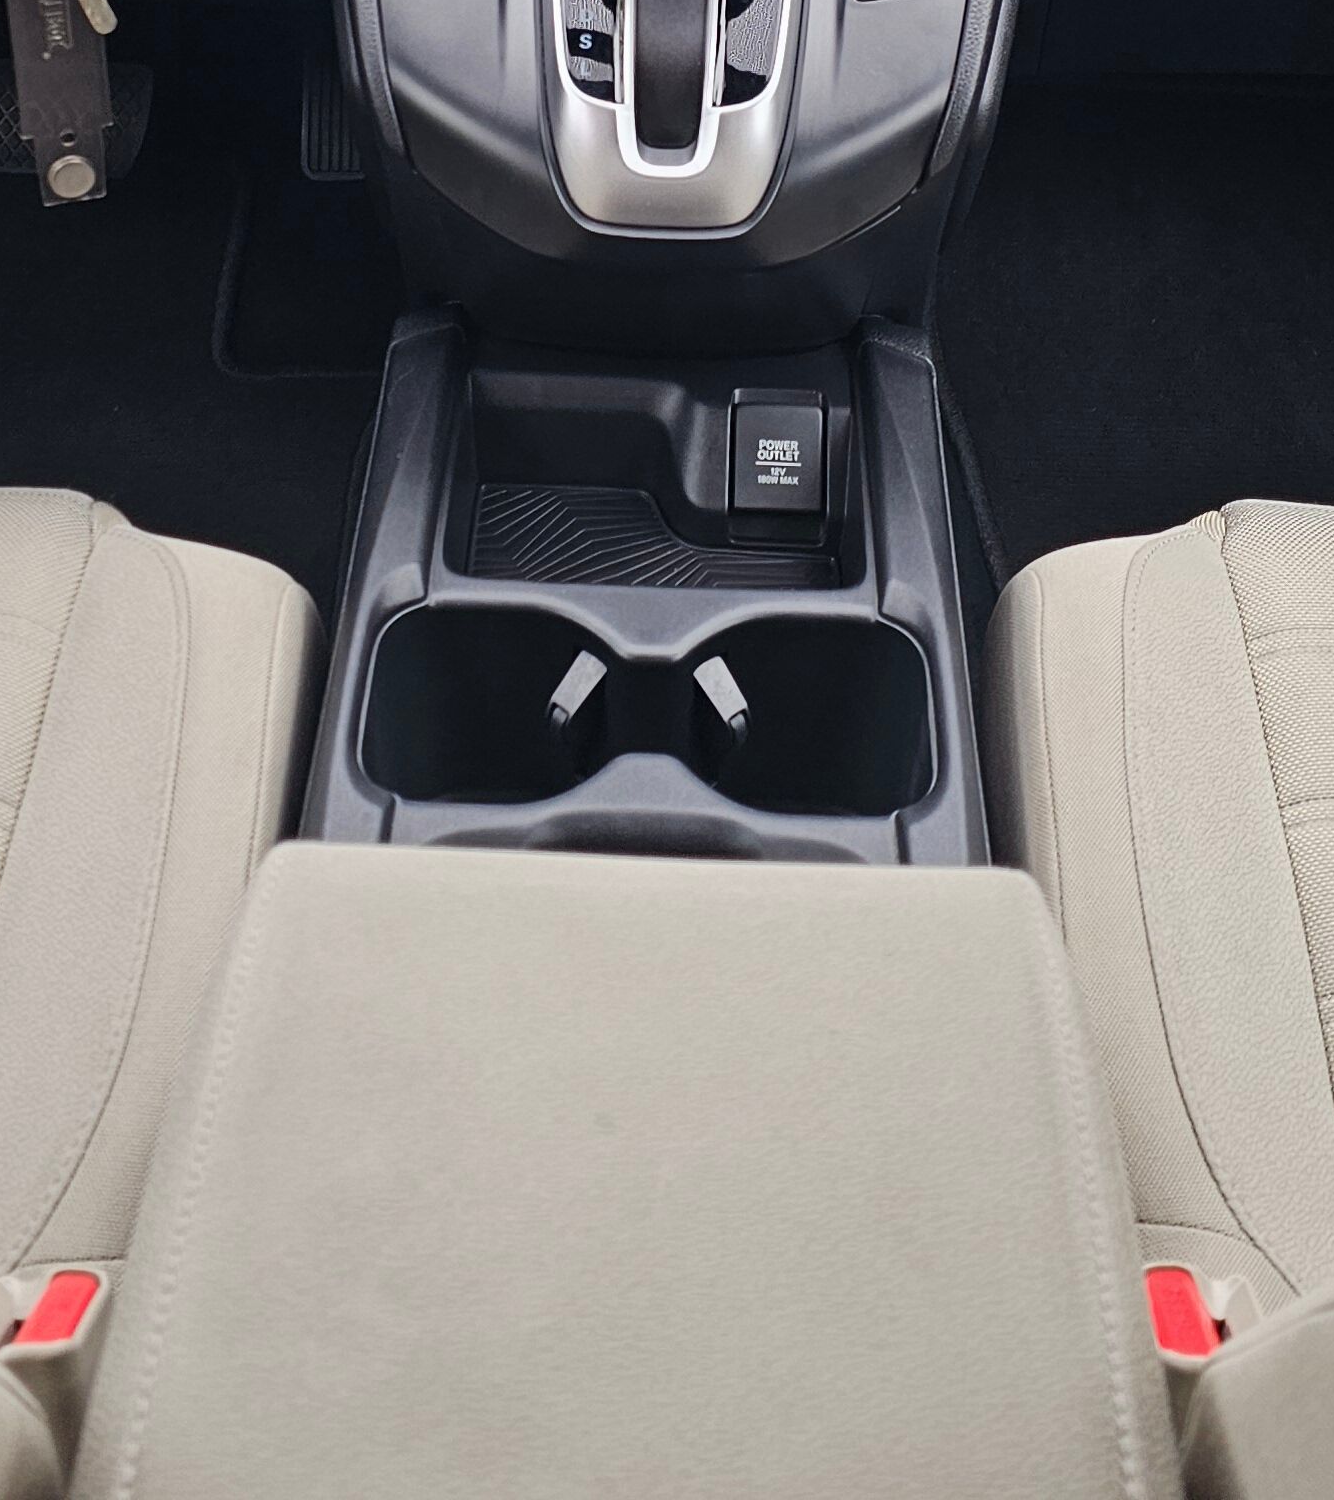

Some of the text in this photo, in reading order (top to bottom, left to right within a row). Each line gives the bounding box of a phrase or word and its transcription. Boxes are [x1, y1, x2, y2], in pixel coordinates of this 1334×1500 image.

[579, 33, 593, 50] S
[758, 438, 799, 451] POWER
[756, 449, 801, 462] OUTLET
[770, 467, 787, 476] 12V
[779, 476, 799, 486] MAX
